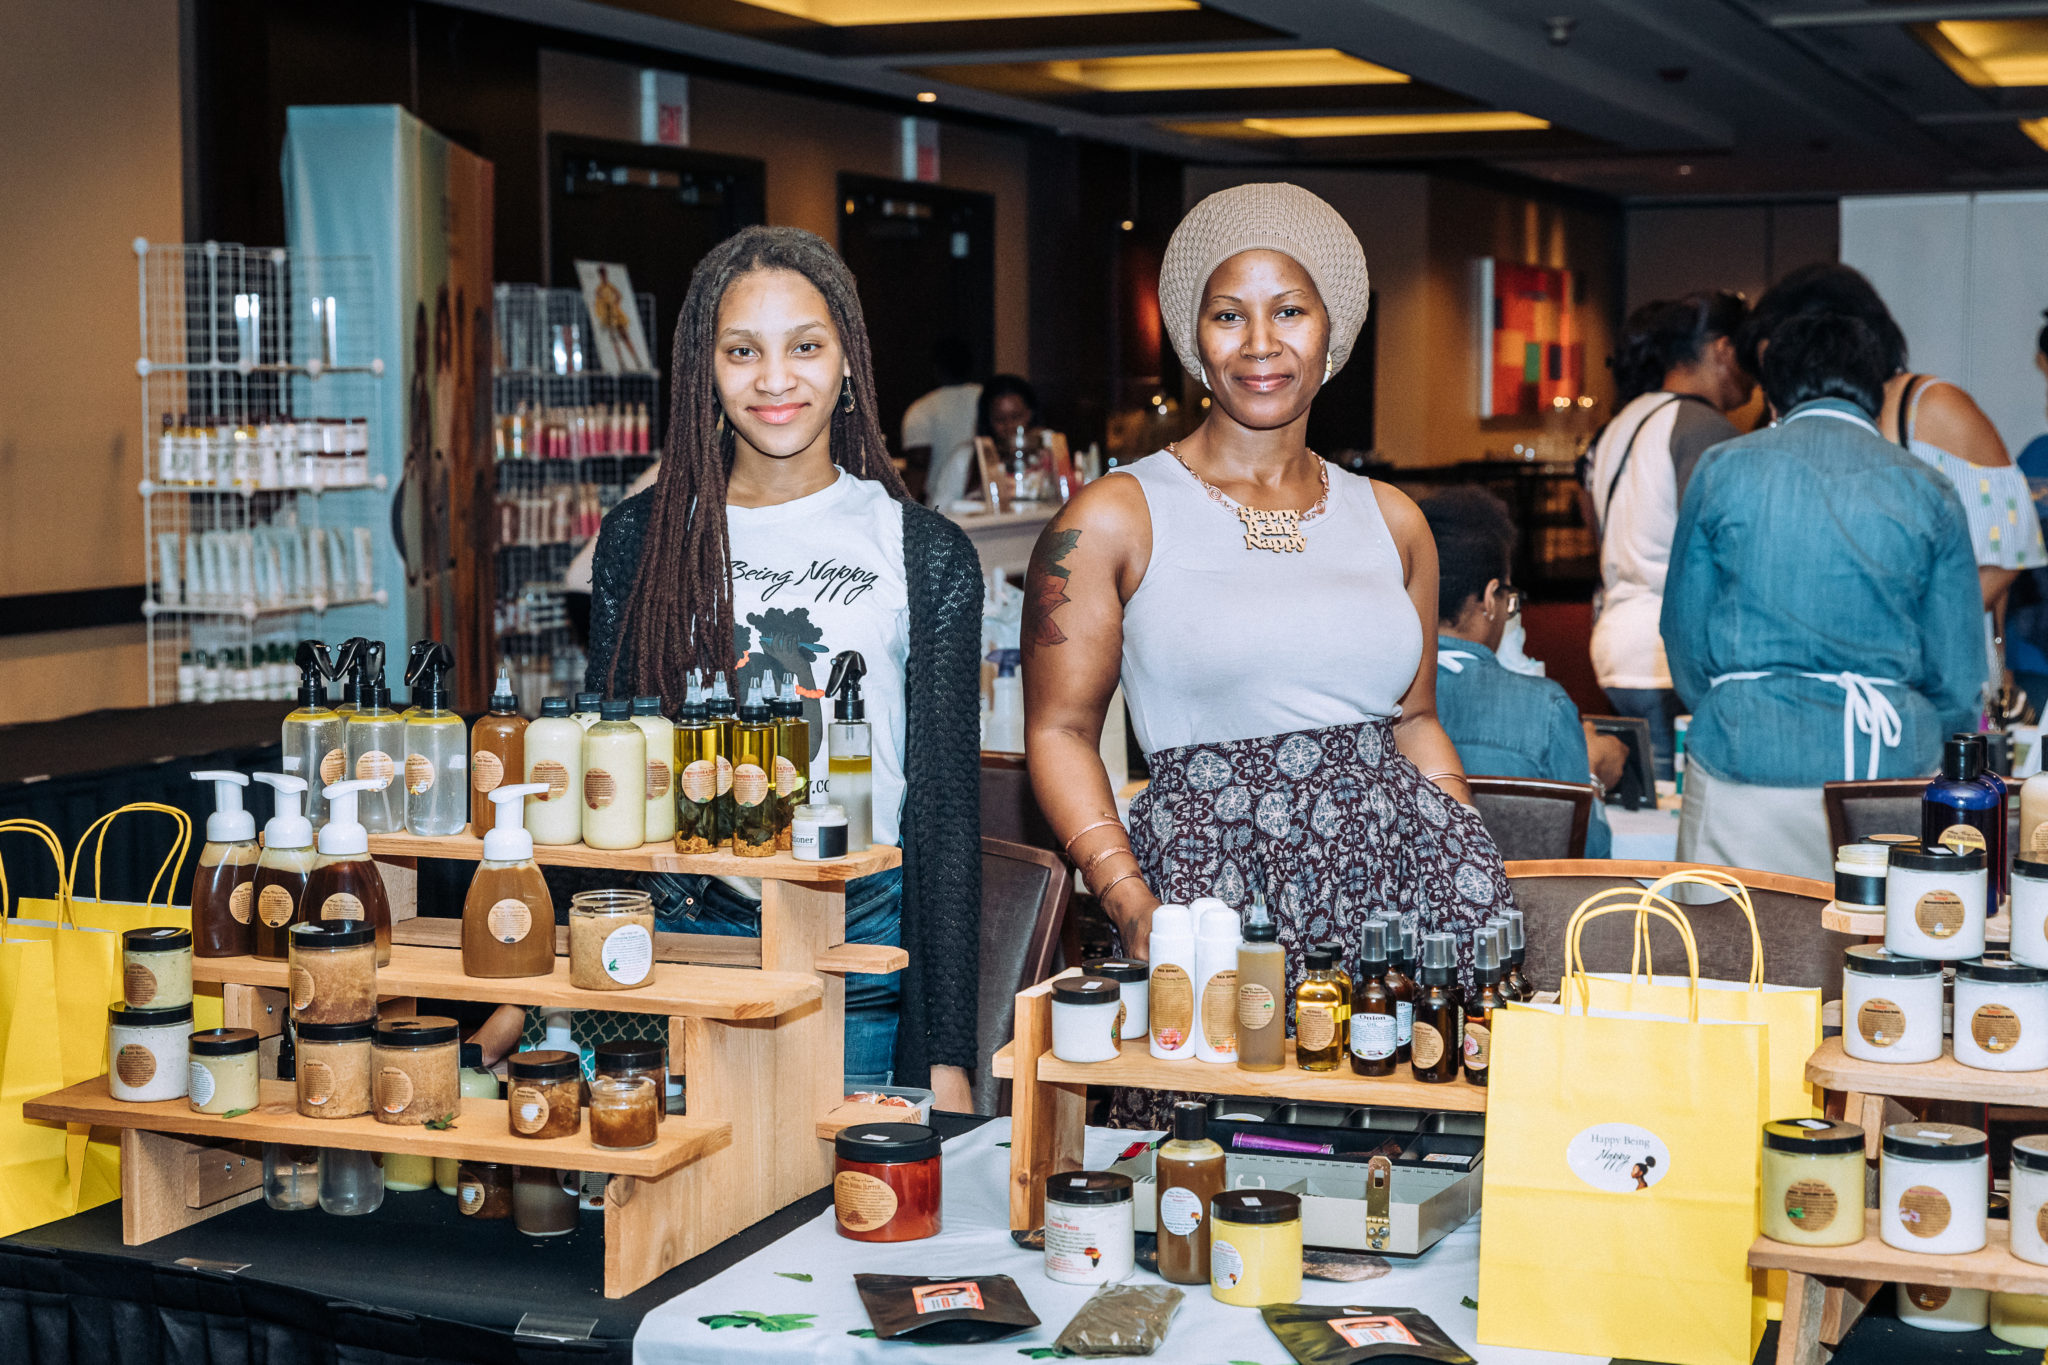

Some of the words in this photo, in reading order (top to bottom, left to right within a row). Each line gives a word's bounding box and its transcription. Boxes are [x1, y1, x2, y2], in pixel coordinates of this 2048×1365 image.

[1238, 507, 1301, 522] Happy
[1248, 521, 1301, 537] Being
[1243, 534, 1307, 553] Nappy
[730, 560, 795, 602] Being
[794, 558, 879, 606] Nappy
[1591, 1134, 1620, 1147] Happy
[1623, 1136, 1651, 1149] Being
[1595, 1148, 1631, 1172] Nappy
